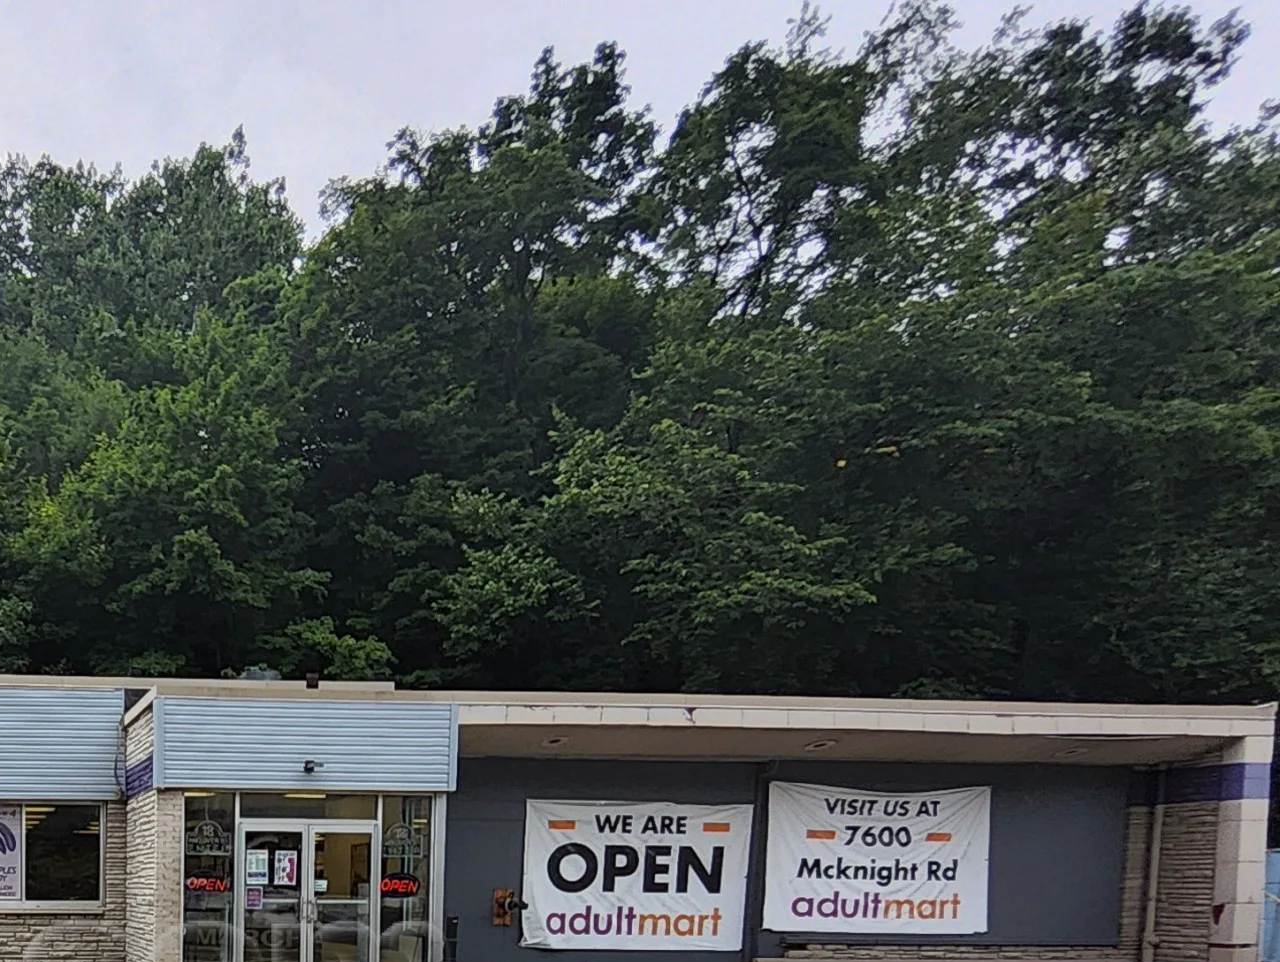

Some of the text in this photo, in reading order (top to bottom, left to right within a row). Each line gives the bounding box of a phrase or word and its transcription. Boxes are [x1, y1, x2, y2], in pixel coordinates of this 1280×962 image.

[824, 798, 941, 817] VISIT US AT
[595, 815, 688, 834] WE ARE
[843, 826, 912, 847] 7600
[547, 842, 725, 894] OPEN
[796, 857, 959, 887] Mcknight Rd
[187, 877, 227, 892] OPEN
[381, 879, 419, 893] OPEN
[791, 891, 961, 920] adultmart
[546, 905, 722, 936] adultmart
